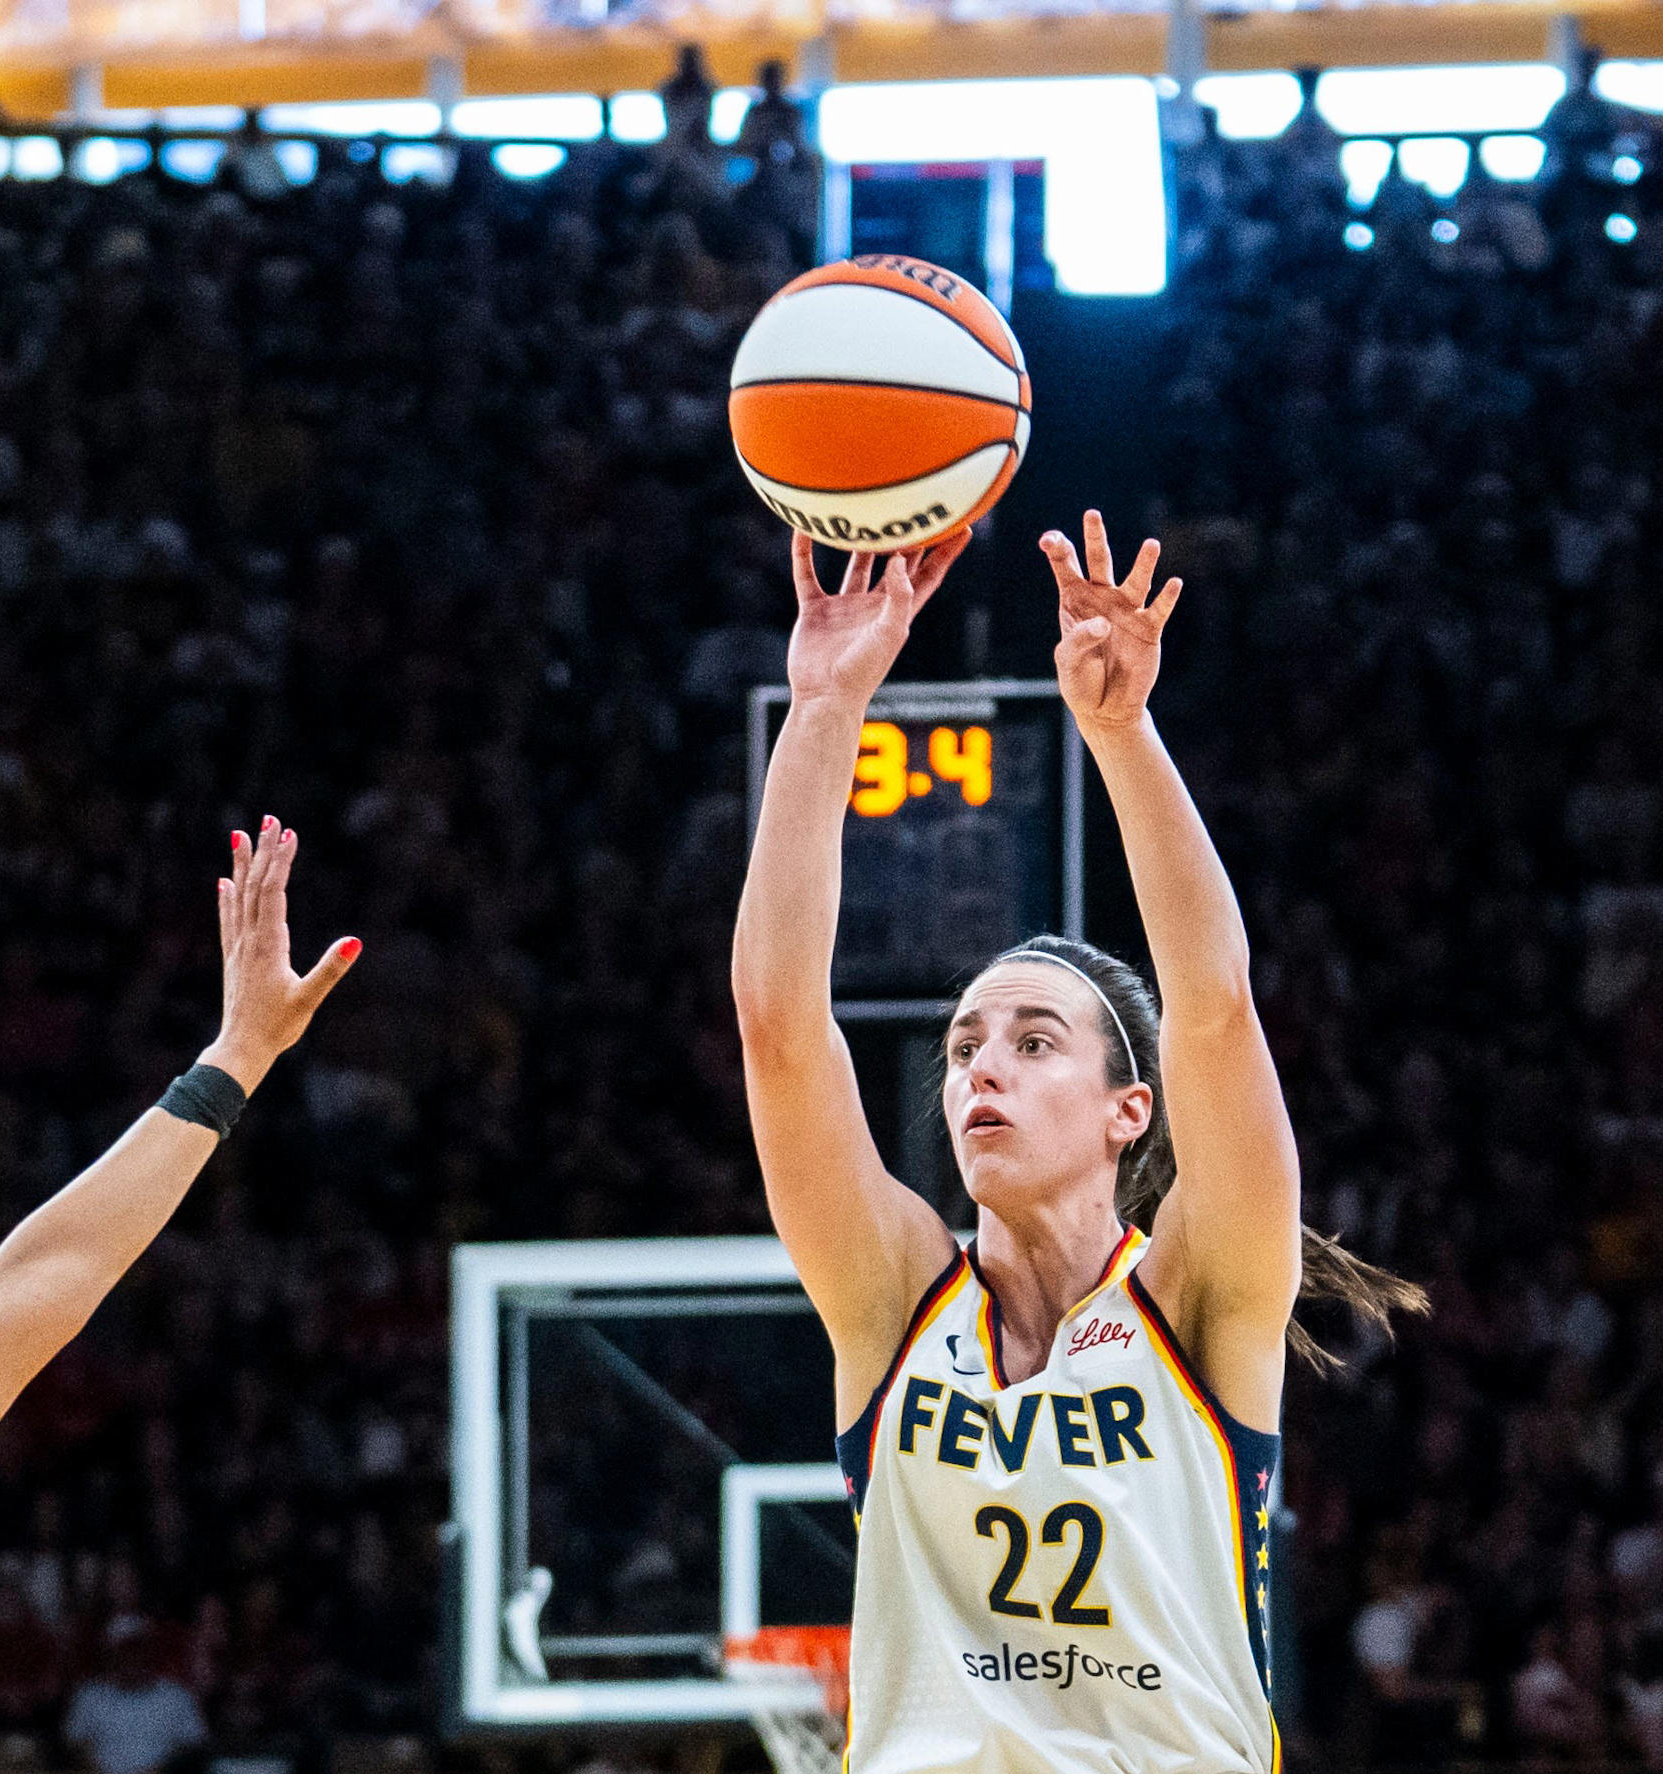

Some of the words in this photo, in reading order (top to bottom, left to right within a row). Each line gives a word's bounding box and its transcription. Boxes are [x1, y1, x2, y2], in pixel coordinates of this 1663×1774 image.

[1067, 1317, 1137, 1356] Lilly
[898, 1375, 1156, 1474] FEVER
[974, 1501, 1112, 1628] 22
[962, 1643, 1162, 1691] salesforce
